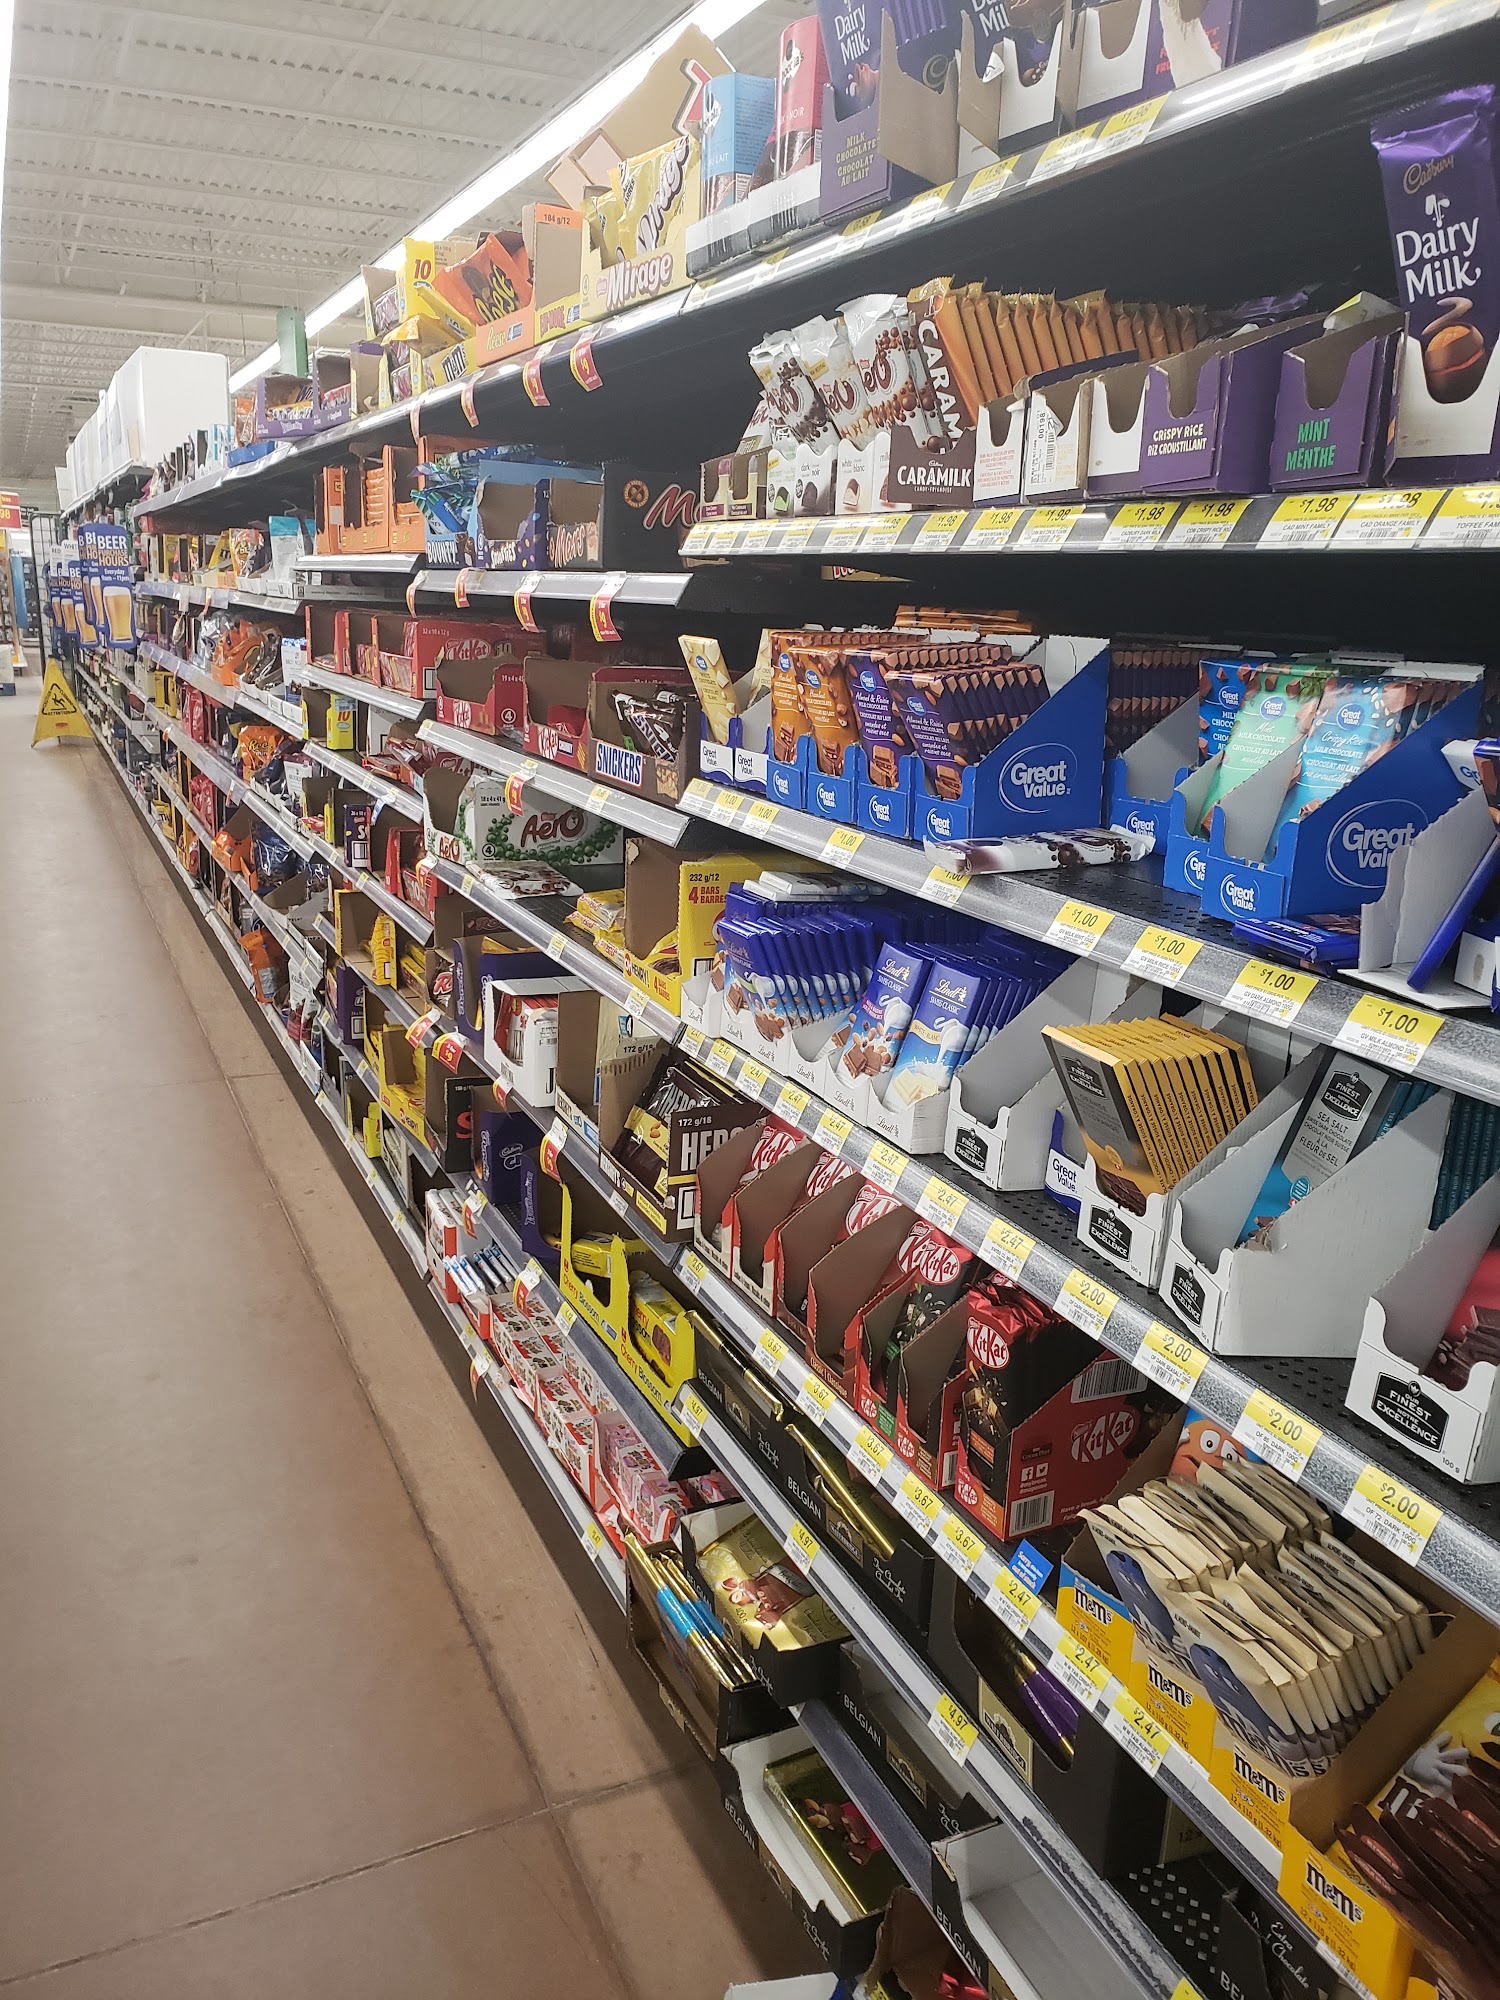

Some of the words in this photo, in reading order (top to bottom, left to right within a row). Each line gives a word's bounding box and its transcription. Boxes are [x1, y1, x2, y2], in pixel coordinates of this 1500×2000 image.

[834, 4, 867, 41] Dairy
[840, 36, 871, 66] Milk
[846, 131, 867, 149] MILK
[836, 139, 877, 164] CHOCOLATE
[837, 157, 874, 177] CHOCOLAT
[1403, 154, 1454, 194] Cadbury
[1396, 216, 1479, 267] Dairy
[413, 259, 432, 280] 10
[1405, 256, 1481, 303] Milk
[606, 253, 673, 310] Mirage
[1297, 418, 1330, 444] MINT
[1286, 445, 1336, 471] MENTHE
[897, 466, 973, 487] CARAMILK
[1134, 506, 1165, 522] $1.98
[1201, 502, 1236, 519] $1.98
[1299, 496, 1339, 514] $1.98
[1373, 520, 1396, 528] ORANGE
[1397, 519, 1422, 527] FAMILY
[97, 535, 128, 549] BEER
[427, 541, 456, 564] BOUNTY
[554, 525, 586, 568] Mars
[98, 549, 128, 557] PURCHASE
[99, 556, 129, 567] HOURS
[105, 568, 125, 576] Everyday
[1221, 690, 1239, 700] Great
[504, 711, 513, 721] 4
[1264, 701, 1283, 711] Great
[1267, 708, 1281, 717] Value
[1341, 709, 1361, 721] Great
[1255, 722, 1277, 734] Mint
[1343, 718, 1360, 726] Value
[1238, 731, 1252, 740] MILK
[1252, 734, 1287, 744] CHOCOLATE
[1322, 731, 1346, 748] Crispy
[1345, 734, 1364, 747] Rice
[703, 744, 717, 759] Great
[705, 756, 718, 767] Value
[737, 754, 753, 768] Great
[1314, 745, 1331, 754] MILK
[1331, 748, 1363, 759] CHOCOLATE
[597, 743, 641, 785] SNICKERS
[1010, 761, 1067, 785] Great
[1306, 758, 1336, 770] CHOCOLAT
[1344, 765, 1360, 775] LAIT
[775, 772, 789, 787] Great
[778, 783, 789, 795] Value
[1023, 781, 1067, 799] Value
[819, 788, 836, 803] Great
[822, 798, 836, 809] Value
[872, 799, 890, 815] Great
[875, 810, 891, 823] Value
[930, 813, 950, 827] Great
[934, 823, 951, 836] Value
[1131, 817, 1154, 831] Great
[840, 832, 858, 847] $1.00
[1342, 822, 1415, 851] Great
[485, 845, 493, 855] 4
[689, 873, 702, 882] 232
[704, 873, 720, 884] g/12
[688, 886, 699, 905] 4
[700, 886, 720, 895] BARS
[1226, 881, 1255, 902] Great
[1232, 898, 1254, 911] Value
[1072, 909, 1099, 928] $1.00
[1154, 934, 1186, 956] $1.00
[632, 962, 650, 988] HENRY!
[881, 958, 904, 978] Lindt
[935, 979, 961, 999] Lindt
[1259, 967, 1296, 991] $1.00
[929, 996, 943, 1006] SWISS
[943, 1001, 961, 1015] CLASSIC
[1251, 992, 1263, 1001] DARK
[1262, 996, 1281, 1008] ALMOND
[1280, 1002, 1292, 1012] 100G
[1377, 1007, 1419, 1034] $1.00
[623, 1045, 637, 1054] 172
[1360, 1032, 1368, 1040] GV
[1368, 1035, 1380, 1044] MILK
[1381, 1038, 1403, 1051] ALMOND
[1404, 1045, 1419, 1057] 100G
[445, 1049, 454, 1062] $9
[1071, 1066, 1094, 1082] FINEST
[1335, 1082, 1361, 1100] FINEST
[1324, 1092, 1359, 1117] EXCELLENCE
[678, 1117, 693, 1127] 172
[694, 1116, 712, 1127] g/18
[876, 1115, 895, 1135] Lindt
[1307, 1115, 1319, 1126] SWISS
[1318, 1121, 1330, 1132] DARK
[1329, 1127, 1353, 1147] CHOCOLATE
[1317, 1111, 1330, 1124] SEA
[1330, 1118, 1348, 1134] SALT
[961, 1137, 981, 1154] FINEST
[1303, 1122, 1324, 1138] CHOCOLAT
[1323, 1132, 1334, 1144] NOIR
[1334, 1140, 1350, 1154] SUISSE
[879, 1145, 899, 1166] $2.47
[956, 1146, 985, 1170] EXCELLENCE
[1300, 1136, 1319, 1156] FLEUR
[1318, 1149, 1327, 1160] DE
[1326, 1153, 1339, 1167] SEL
[1052, 1158, 1077, 1183] Great
[1057, 1172, 1077, 1193] Value
[937, 1185, 959, 1207] $2.47
[1098, 1217, 1123, 1239] FINEST
[1000, 1228, 1025, 1250] $2.47
[1090, 1226, 1128, 1257] EXCELLENCE
[921, 1244, 959, 1282] KitKat
[563, 1272, 580, 1300] Cherry
[579, 1291, 601, 1323] Blossom
[1080, 1280, 1106, 1306] $2.00
[1178, 1277, 1198, 1301] FINEST
[1172, 1286, 1201, 1322] EXCELLENCE
[969, 1324, 1009, 1367] KitKat
[1162, 1333, 1192, 1363] $2.00
[621, 1343, 639, 1374] Cherry
[638, 1362, 662, 1400] Blossom
[698, 1370, 724, 1404] BELGIAN
[813, 1381, 829, 1401] $3.67
[1389, 1389, 1432, 1421] FINEST
[1404, 1392, 1420, 1405] OUR
[1268, 1406, 1303, 1441] $2.00
[1375, 1400, 1438, 1447] EXCELLENCE
[1396, 1408, 1420, 1426] NOTRE
[866, 1434, 885, 1457] $3.67
[1072, 1412, 1135, 1462] KitKat
[1020, 1477, 1047, 1488] #mybreak
[787, 1476, 822, 1521] BELGIAN
[914, 1486, 934, 1510] $3.67
[1380, 1482, 1421, 1521] $2.00
[798, 1528, 814, 1550] $4.97
[955, 1526, 976, 1551] $3.67
[1008, 1579, 1032, 1606] $2.47
[1075, 1643, 1101, 1673] $2.47
[843, 1692, 883, 1749] BELGIAN
[948, 1704, 969, 1731] $4.97
[1133, 1707, 1162, 1740] $2.47
[725, 1797, 756, 1851] BELGIAN
[936, 1906, 982, 1980] BELGIAN
[1270, 1921, 1294, 1951] Extra
[1271, 1942, 1310, 1990] Chocolate
